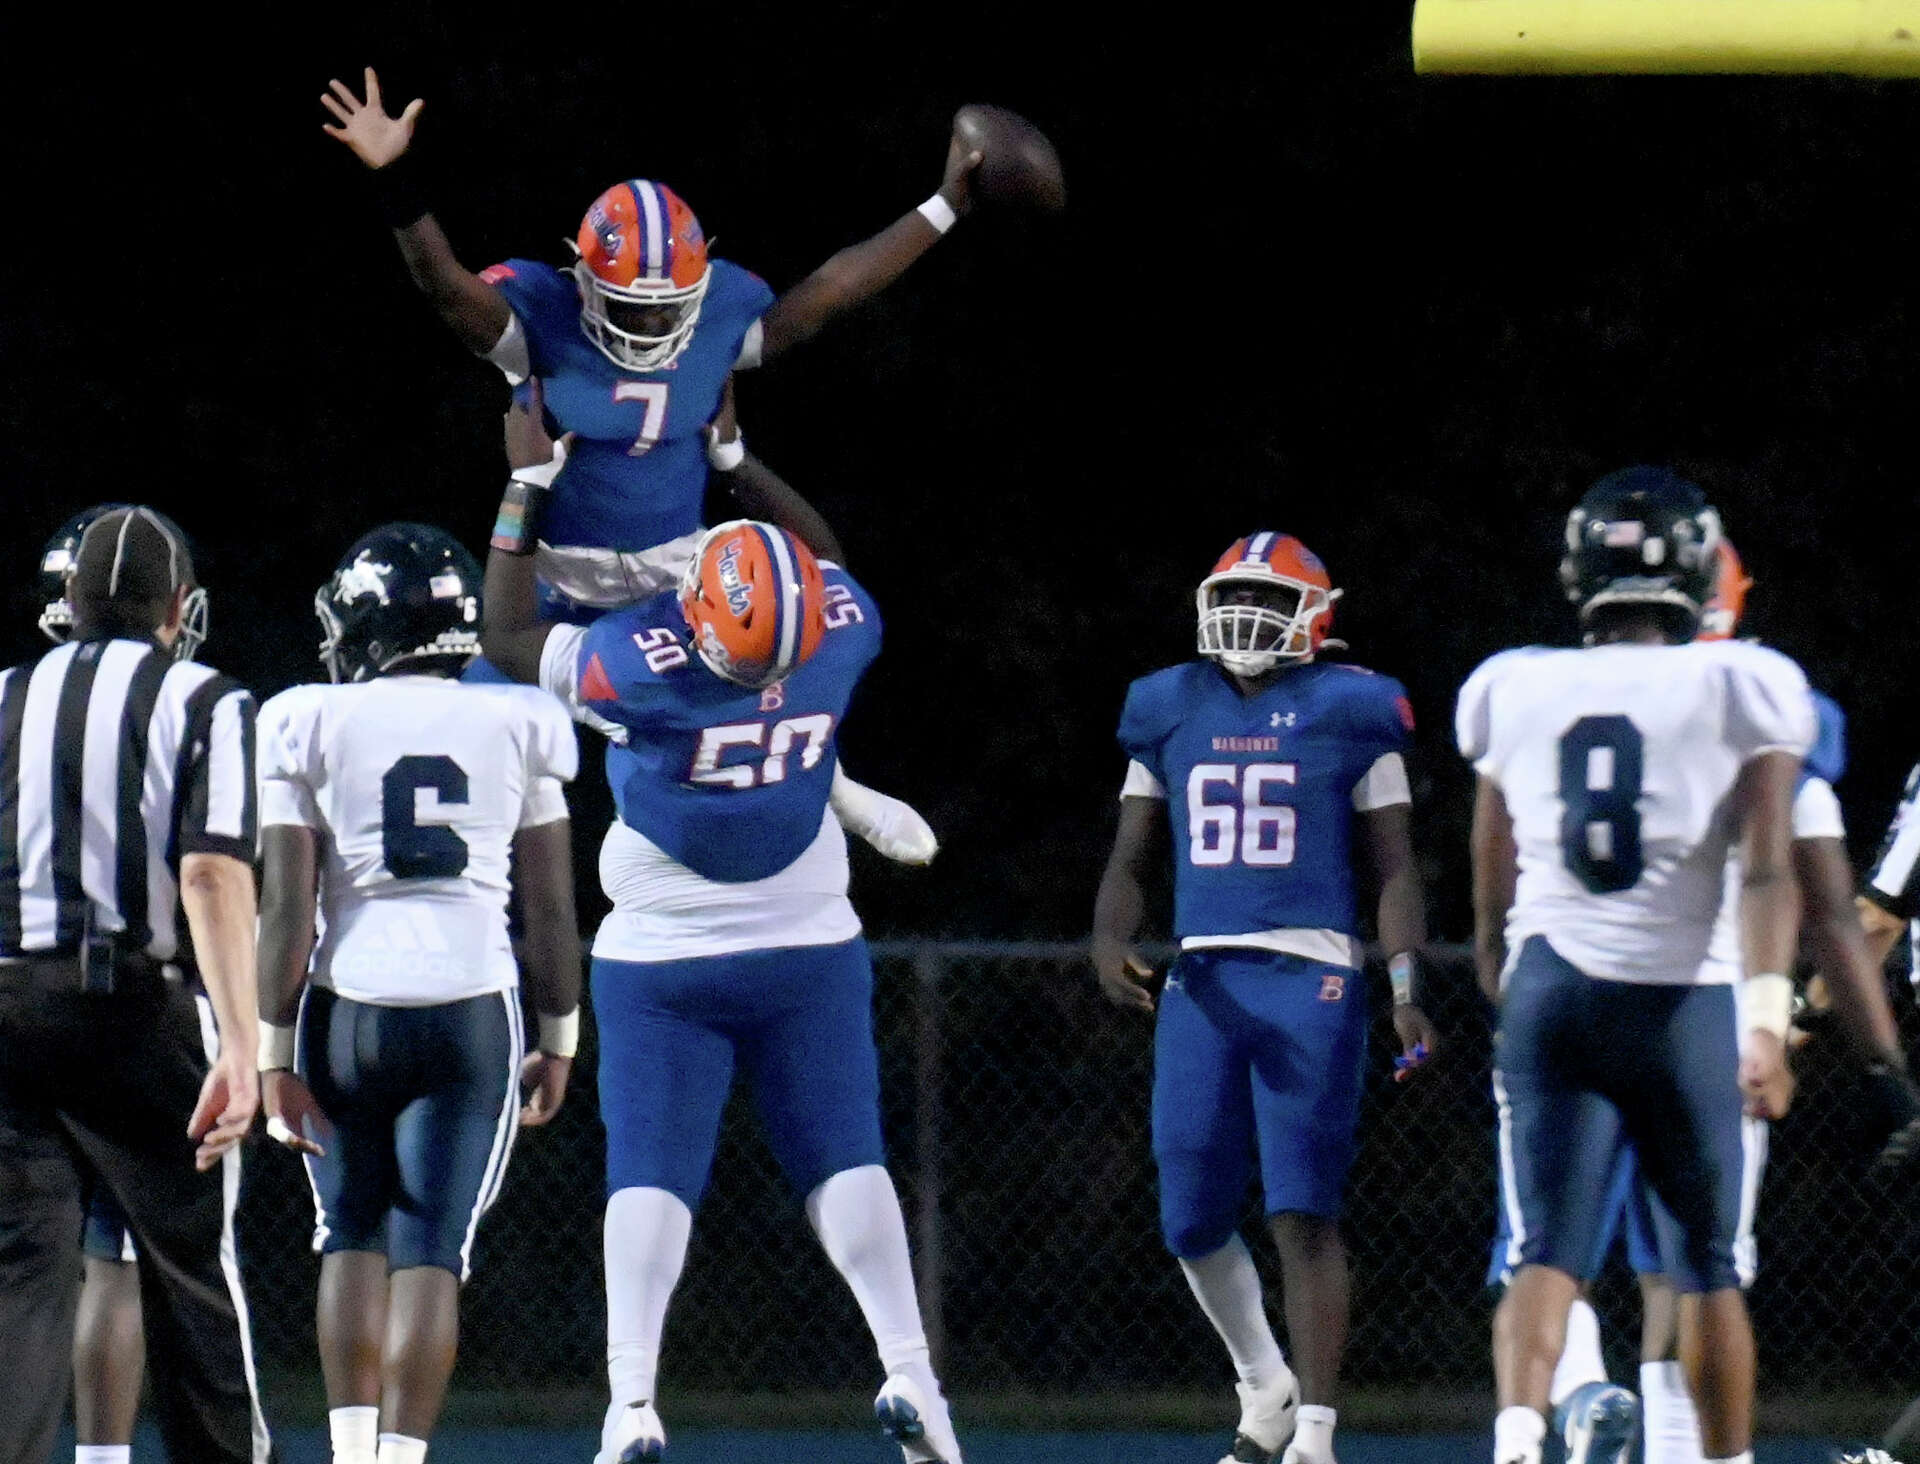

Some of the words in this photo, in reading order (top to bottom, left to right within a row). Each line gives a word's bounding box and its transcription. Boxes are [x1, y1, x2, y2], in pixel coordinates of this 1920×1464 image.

[613, 379, 669, 457] 7
[632, 627, 689, 673] 50
[689, 713, 835, 789] 50
[382, 754, 470, 880] 6
[1187, 762, 1297, 866] 66
[1560, 713, 1644, 894] 8
